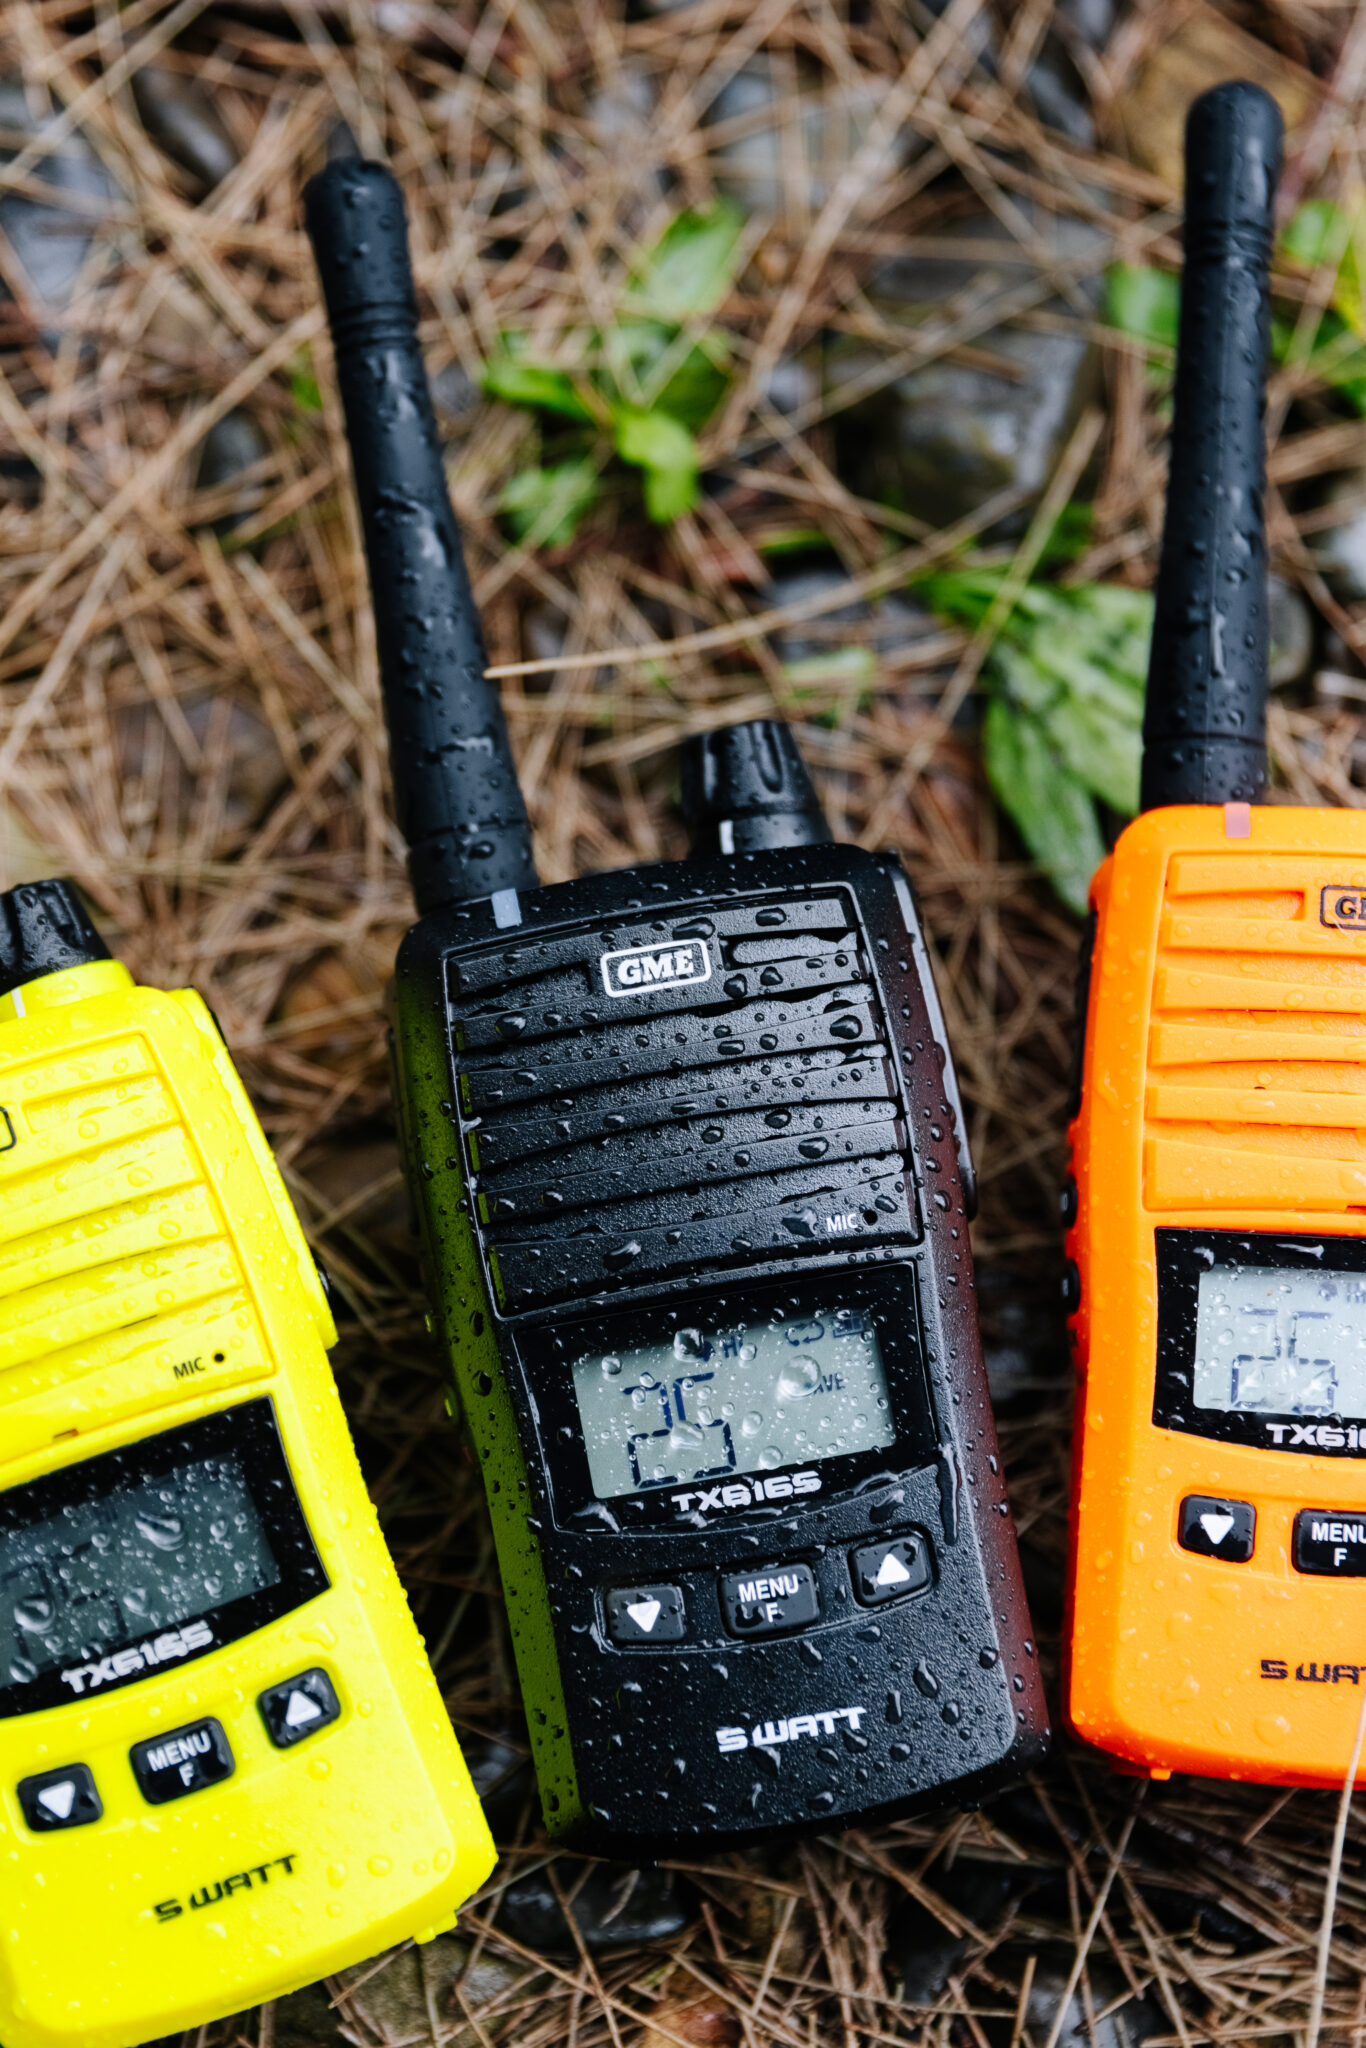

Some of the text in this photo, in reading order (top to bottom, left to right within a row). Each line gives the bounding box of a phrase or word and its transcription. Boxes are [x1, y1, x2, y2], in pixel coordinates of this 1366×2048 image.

[617, 949, 694, 986] GME
[826, 1213, 859, 1232] MIC
[172, 1356, 206, 1380] MIC
[1333, 1547, 1348, 1567] F
[738, 1574, 799, 1604] MENU
[765, 1602, 779, 1623] F
[1295, 1662, 1366, 1685] WA
[751, 1706, 867, 1746] WATT
[146, 1730, 212, 1772] MENU
[178, 1763, 196, 1787] F
[189, 1853, 297, 1911] WATT
